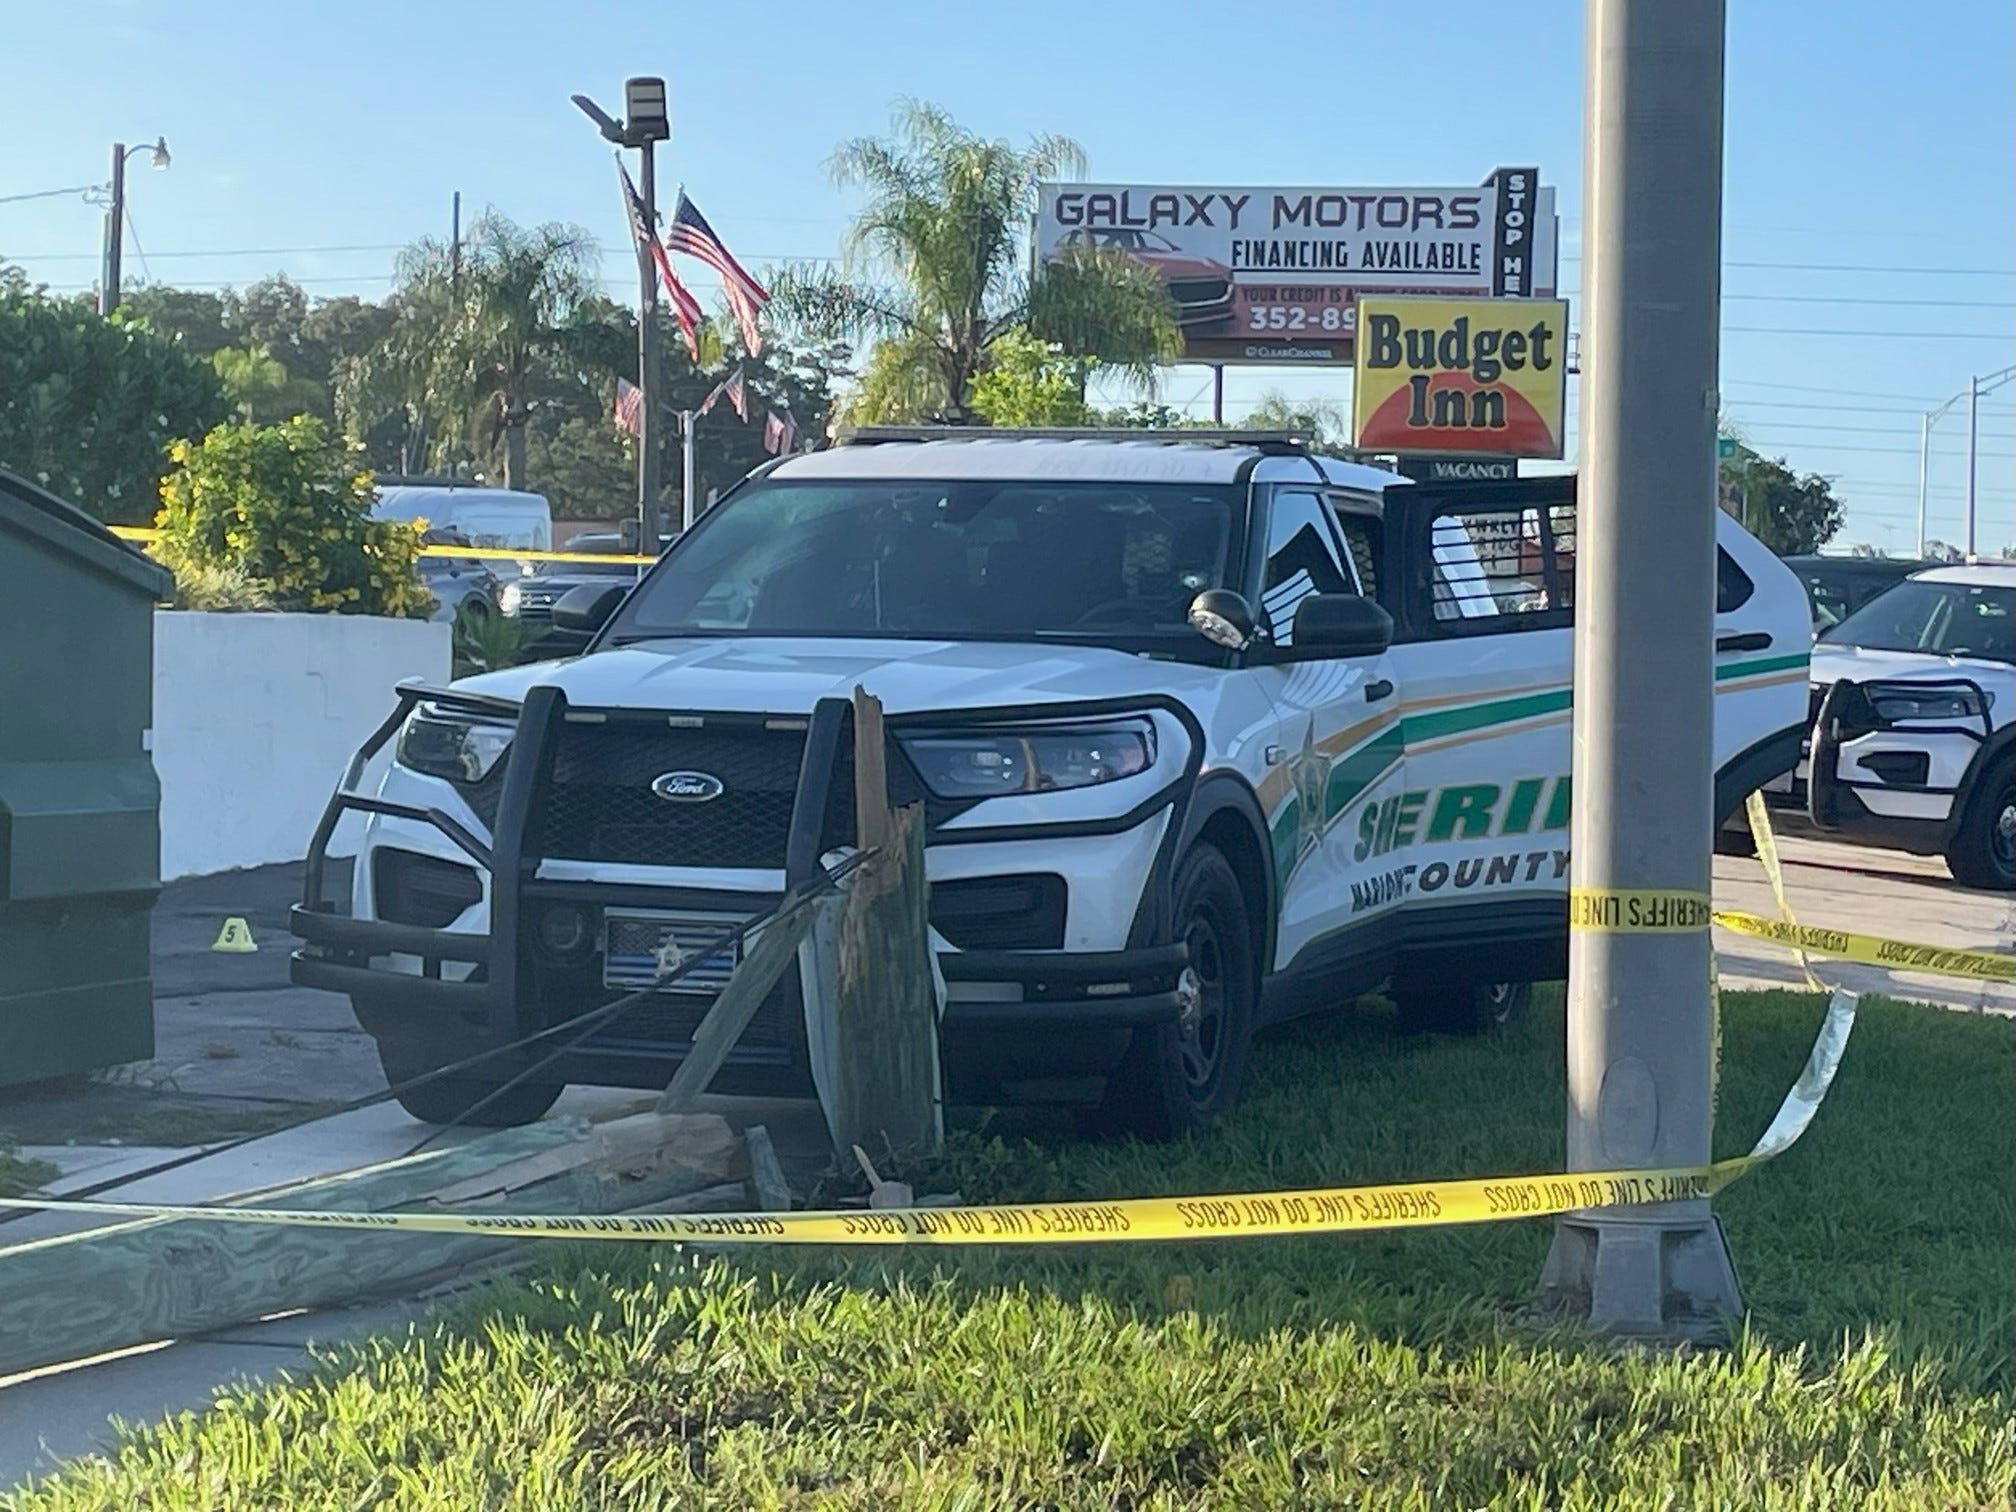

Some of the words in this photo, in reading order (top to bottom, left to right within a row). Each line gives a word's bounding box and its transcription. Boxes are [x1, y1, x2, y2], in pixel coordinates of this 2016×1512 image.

[1056, 189, 1250, 230] GALAXY
[1273, 194, 1481, 232] MOTORS
[1505, 174, 1525, 246] STOP
[1232, 239, 1348, 268] FINANCING
[1362, 240, 1481, 270] AVAILABLE
[1241, 287, 1277, 302] YOUR
[1281, 287, 1325, 302] CREDIT
[1329, 288, 1341, 302] IS
[1367, 314, 1553, 383] Budget
[1408, 375, 1506, 428] Inn
[1435, 462, 1511, 479] VACANCY
[666, 776, 706, 794] Ford
[1583, 896, 1619, 927] LINE
[225, 925, 237, 943] 5
[1484, 1184, 1541, 1213] CROSS
[1543, 1182, 1576, 1210] NOT
[1579, 1181, 1603, 1207] DO
[1605, 1178, 1642, 1205] LINE
[1177, 1201, 1241, 1228] CROSS
[1241, 1199, 1280, 1226] NOT
[1281, 1198, 1309, 1225] DO
[1308, 1195, 1353, 1223] LINE
[1353, 1190, 1441, 1221] SHERIFF'S
[838, 1212, 908, 1234] CROSS
[908, 1211, 952, 1234] NOT
[951, 1211, 985, 1234] DO
[982, 1209, 1033, 1234] LINE
[1032, 1206, 1130, 1233] SHERIFF'S
